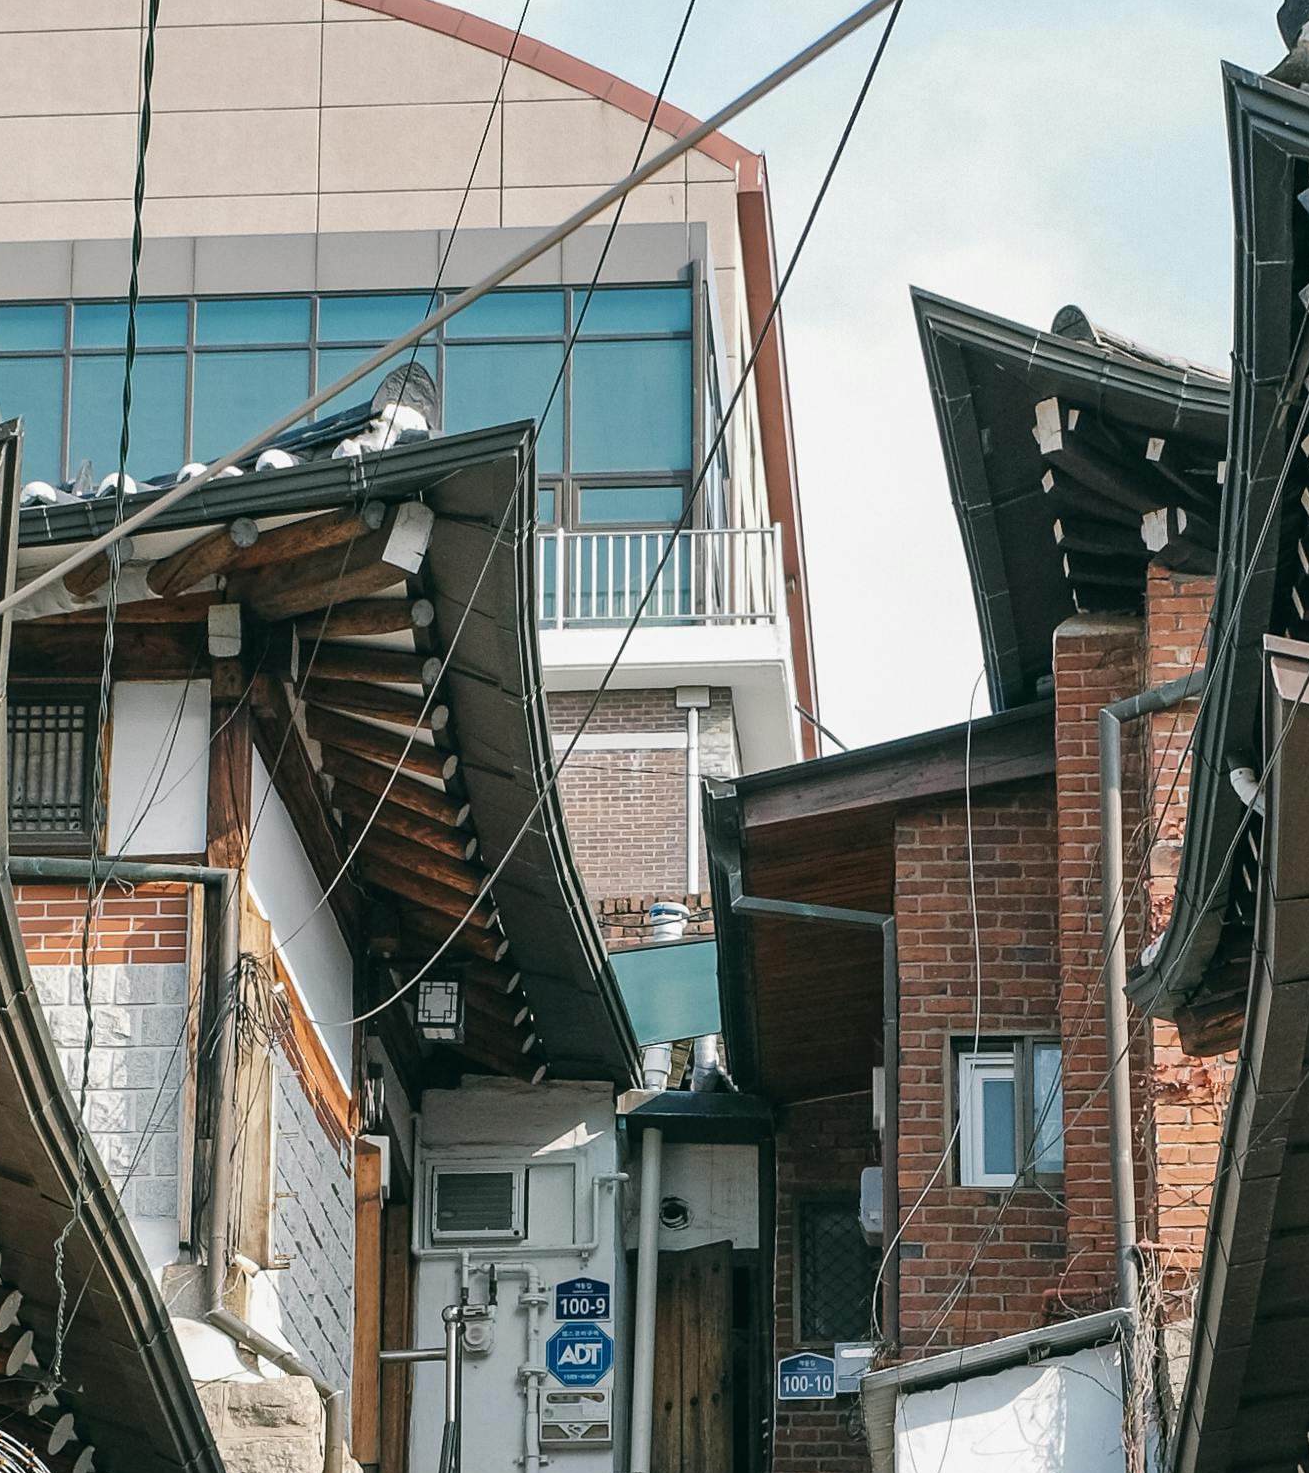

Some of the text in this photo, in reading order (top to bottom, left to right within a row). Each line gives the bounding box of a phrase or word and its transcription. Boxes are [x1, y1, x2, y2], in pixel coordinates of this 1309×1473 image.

[560, 1297, 606, 1316] 100-9
[557, 1342, 603, 1365] ADT
[783, 1374, 832, 1393] 100-10
